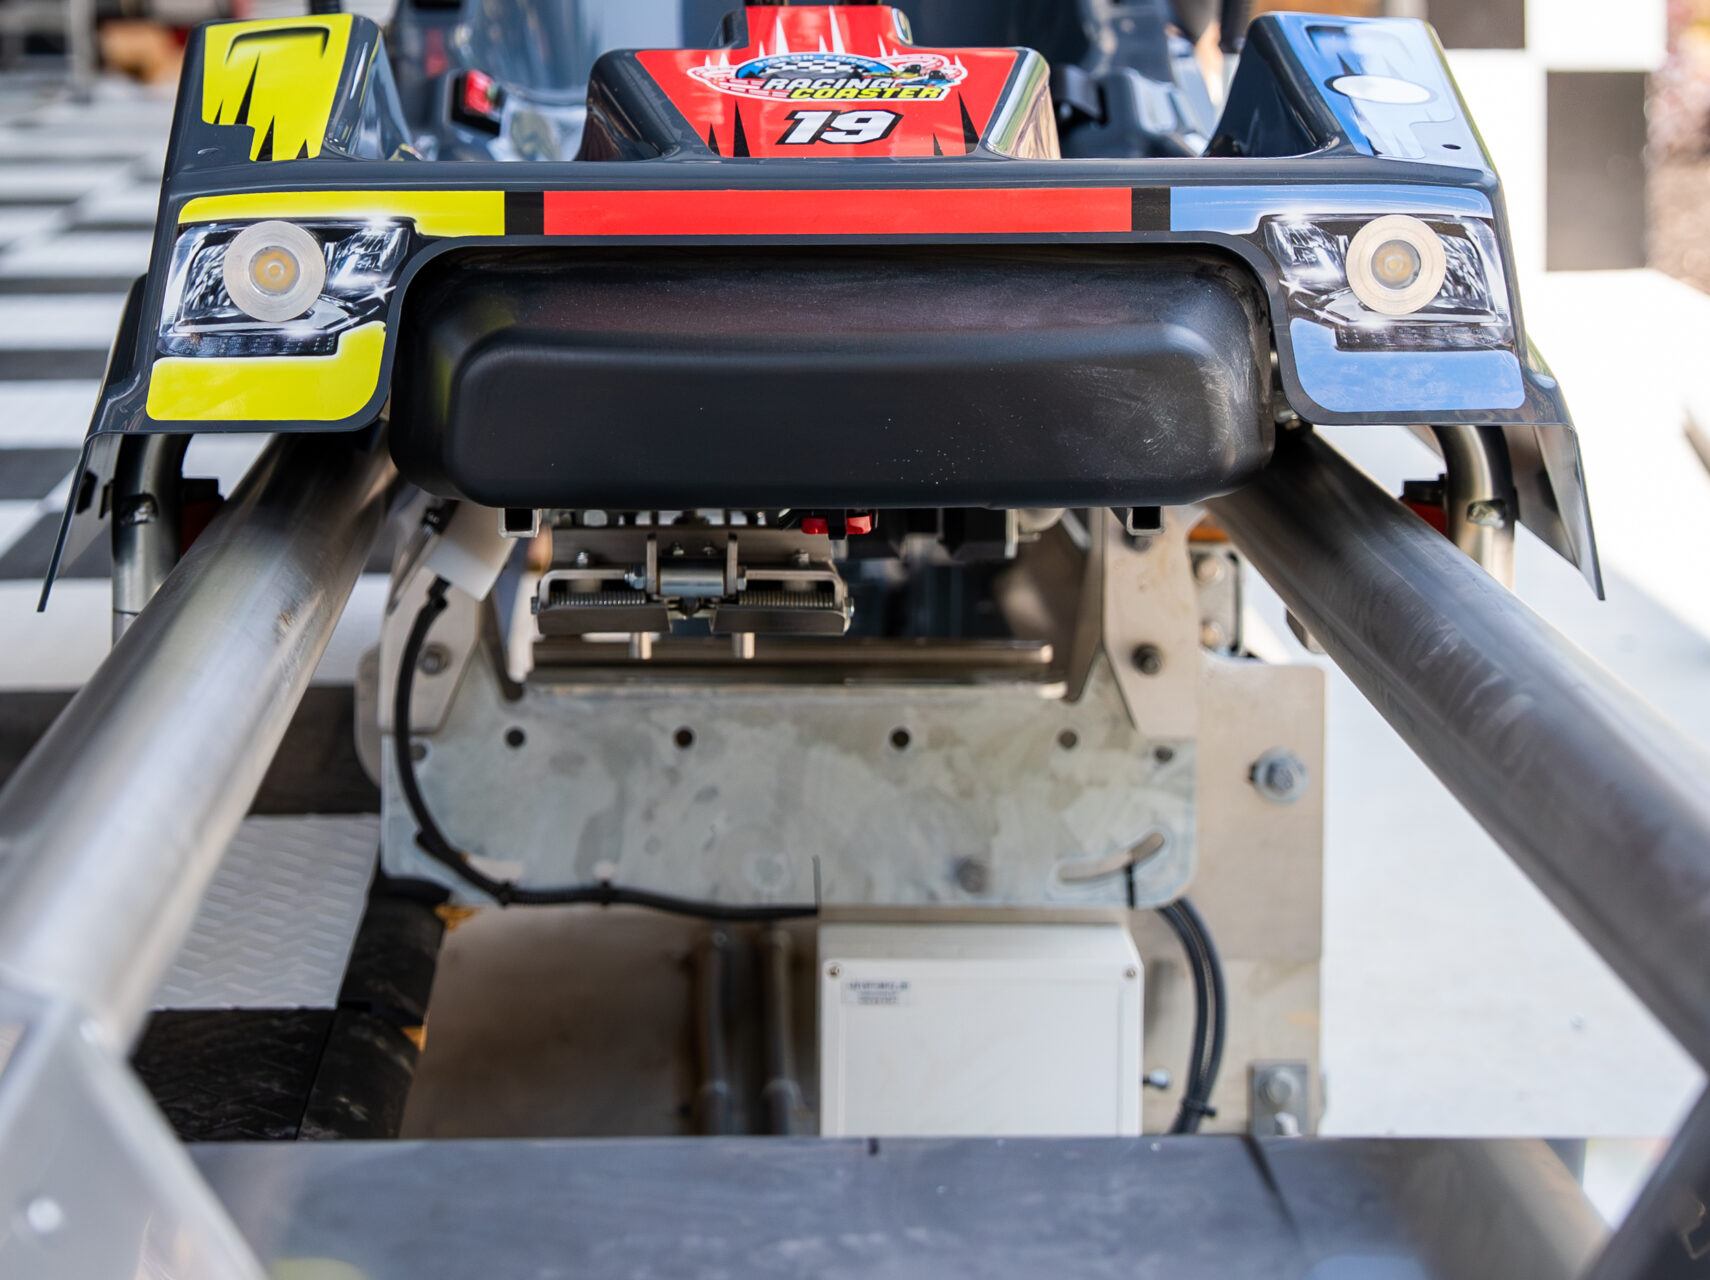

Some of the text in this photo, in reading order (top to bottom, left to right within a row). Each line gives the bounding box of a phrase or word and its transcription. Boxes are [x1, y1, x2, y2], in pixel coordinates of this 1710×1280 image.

[764, 77, 893, 90] RACING
[789, 88, 943, 99] COASTER
[779, 110, 902, 144] 19
